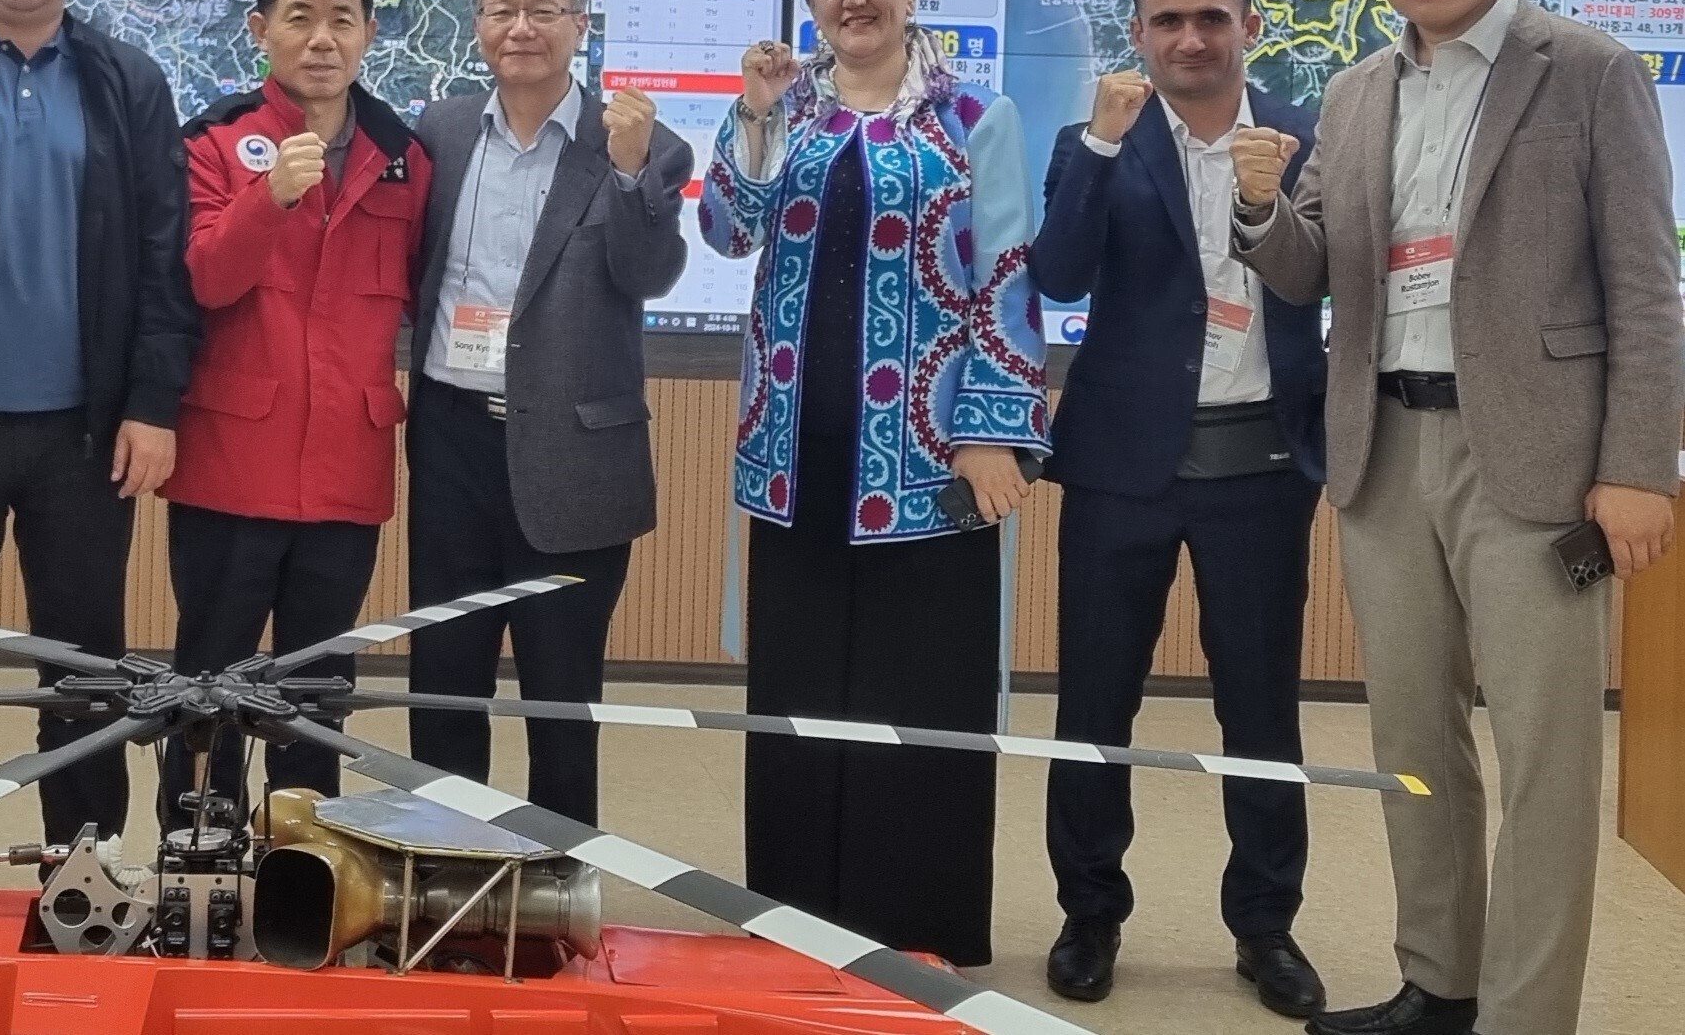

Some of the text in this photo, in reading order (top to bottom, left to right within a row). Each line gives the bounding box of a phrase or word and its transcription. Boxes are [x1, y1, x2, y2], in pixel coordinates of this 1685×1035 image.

[1583, 4, 1685, 20] 주민대피 309명
[967, 37, 984, 58] 명
[975, 62, 991, 74] 28
